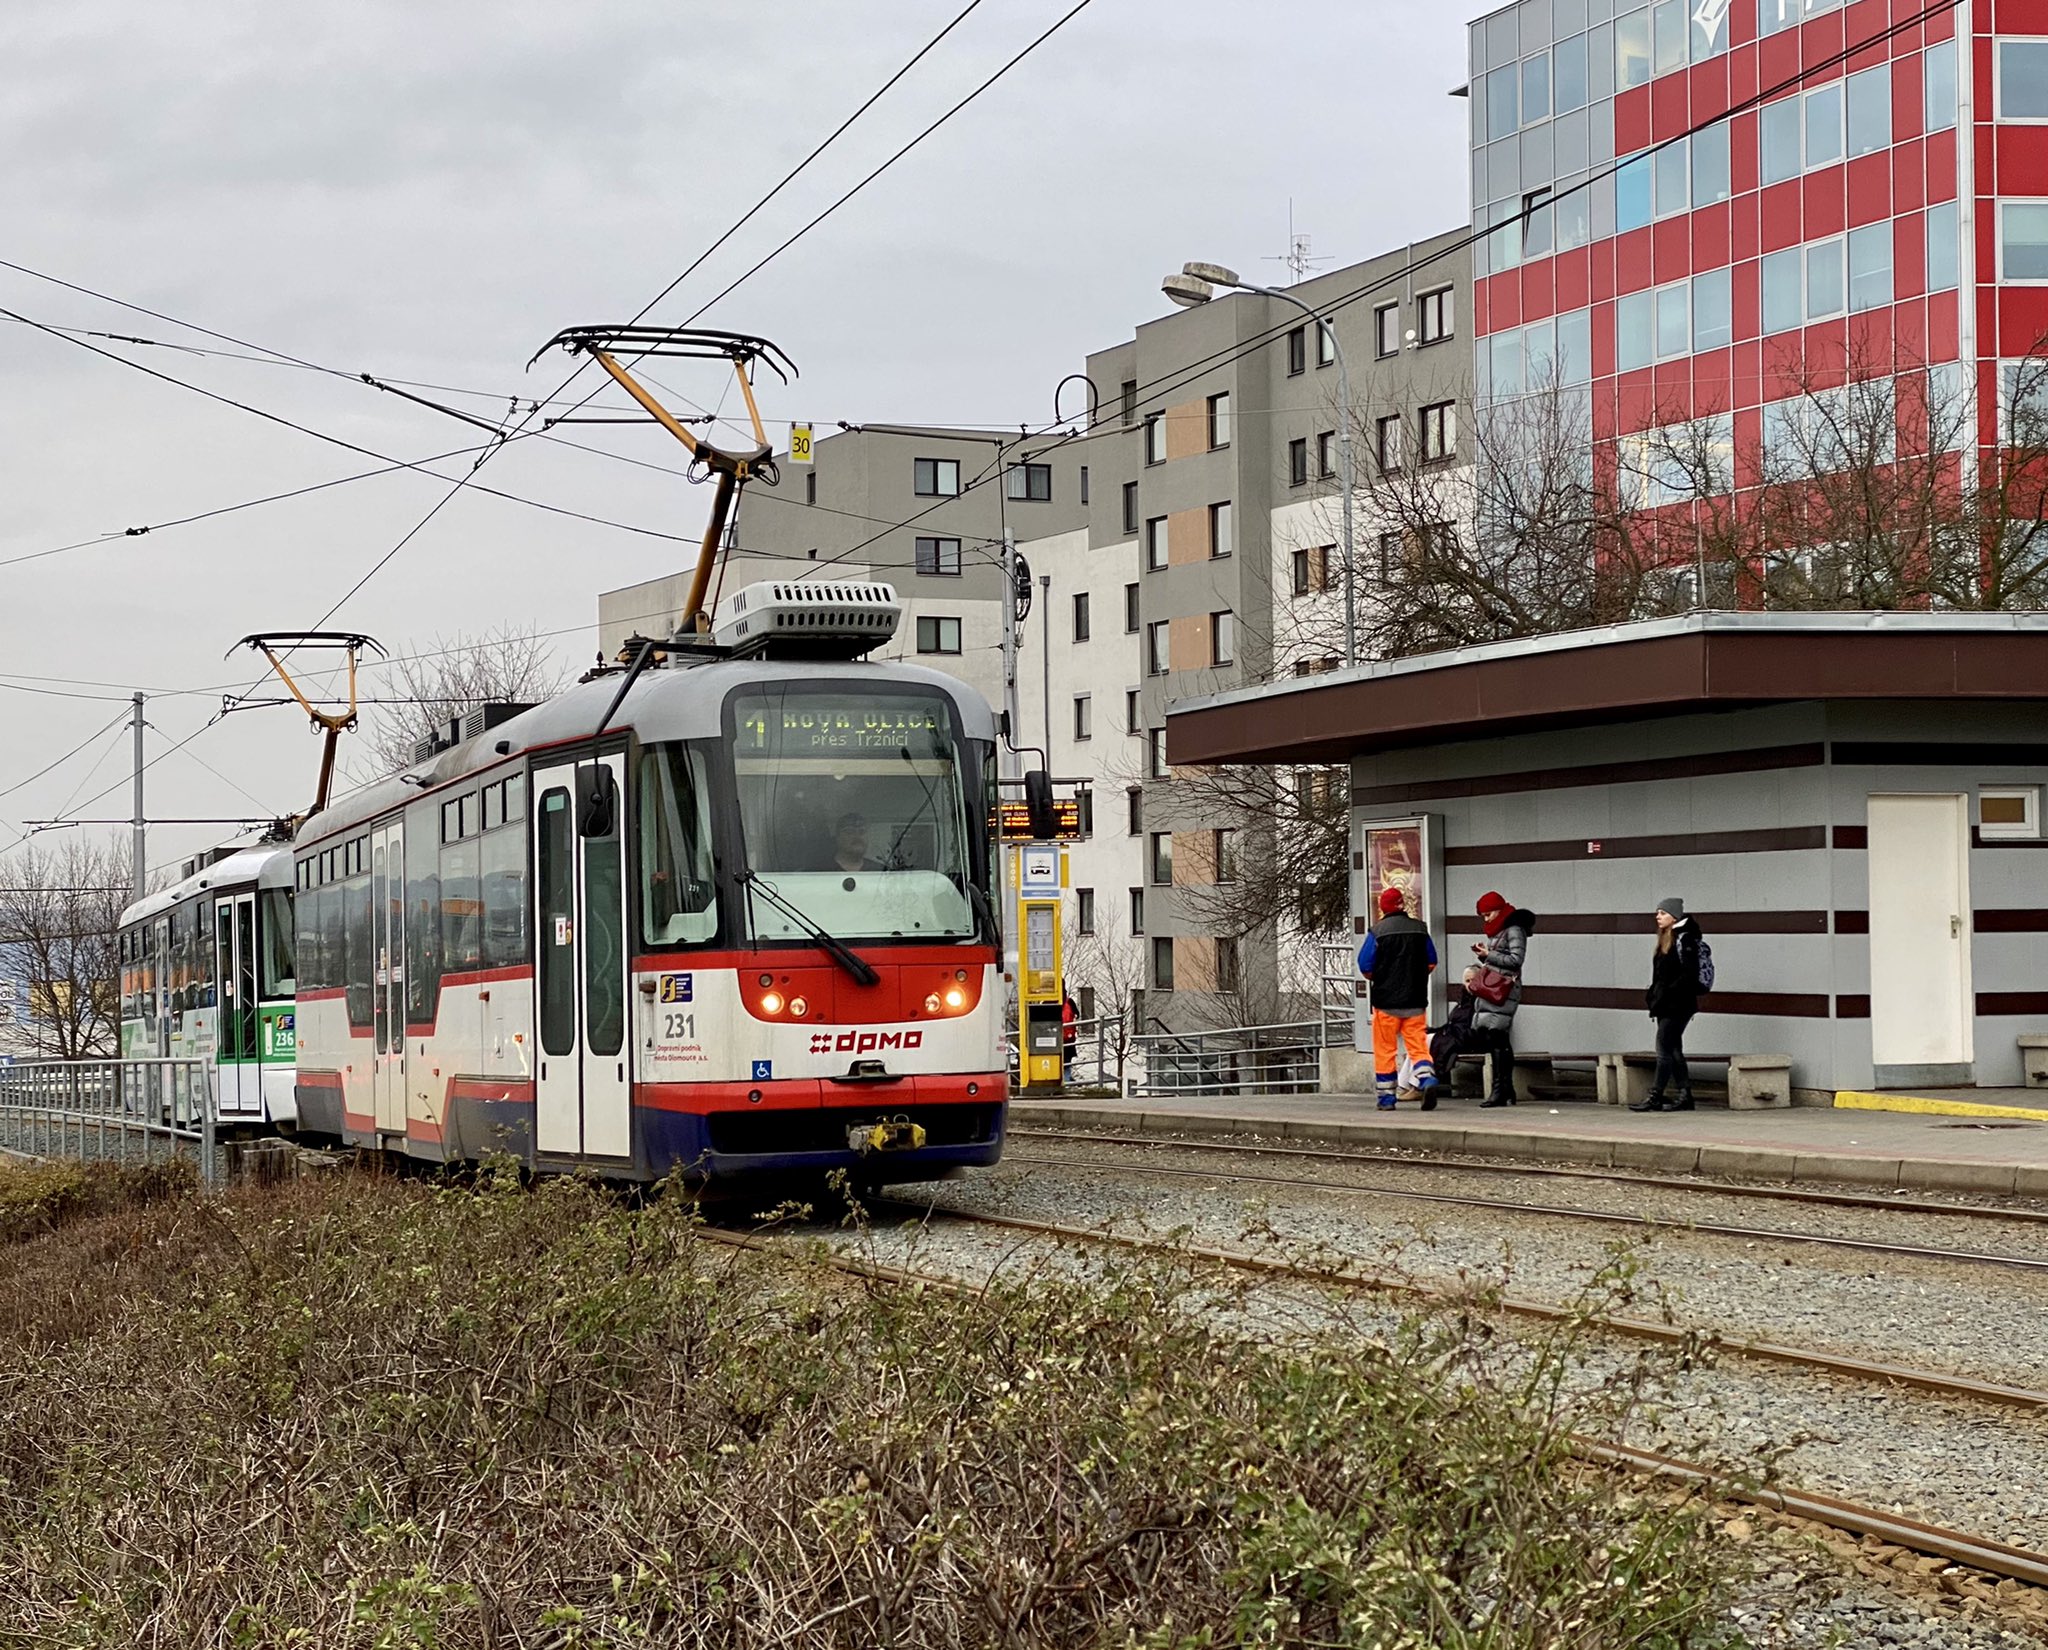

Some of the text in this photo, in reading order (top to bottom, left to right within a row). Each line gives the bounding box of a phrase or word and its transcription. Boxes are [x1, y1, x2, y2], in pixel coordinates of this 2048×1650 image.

[792, 436, 810, 454] 30
[746, 709, 764, 747] 1
[811, 729, 847, 746] přes
[665, 1013, 694, 1039] 231
[275, 1032, 294, 1046] 236
